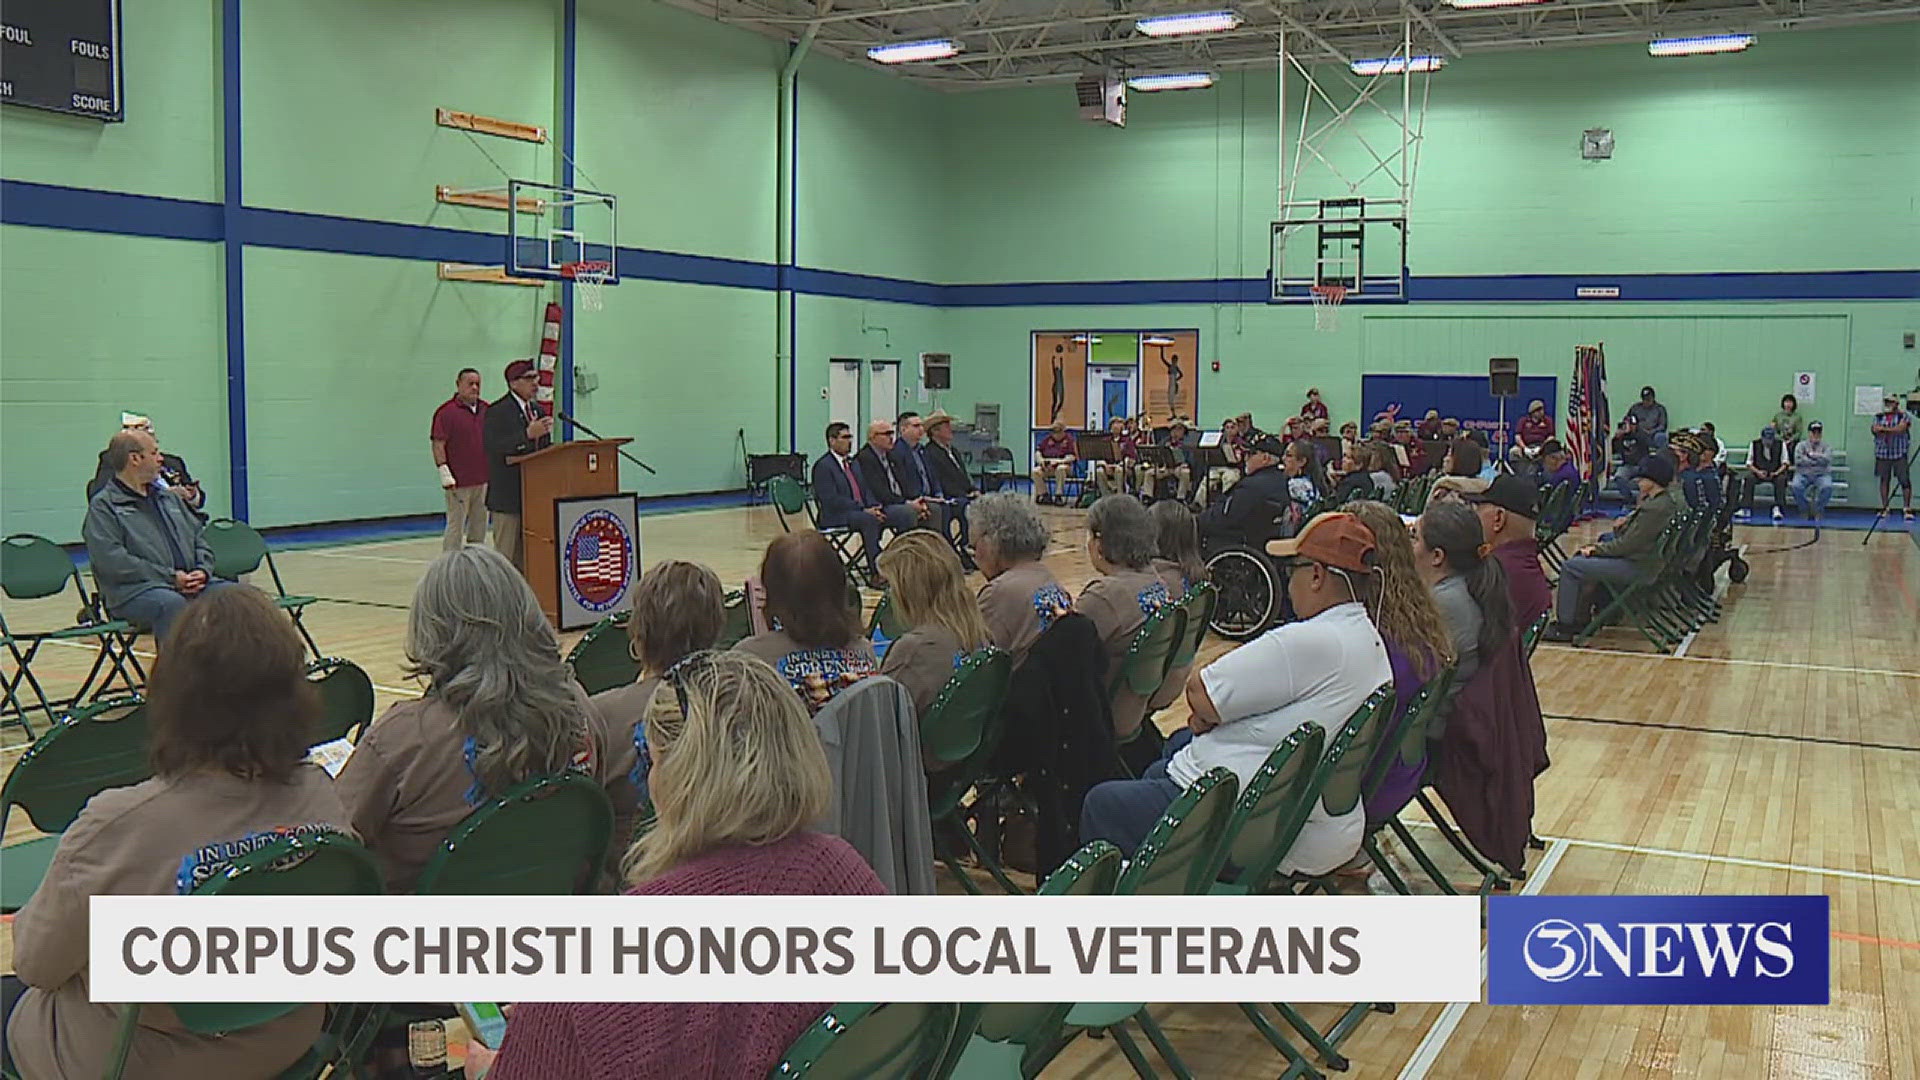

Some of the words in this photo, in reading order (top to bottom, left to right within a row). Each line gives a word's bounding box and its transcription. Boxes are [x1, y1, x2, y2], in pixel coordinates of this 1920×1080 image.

[0, 26, 32, 45] FOUL
[71, 40, 110, 59] FOULS
[72, 94, 111, 111] SCORE
[197, 846, 219, 864] IN
[226, 834, 279, 857] UNITY
